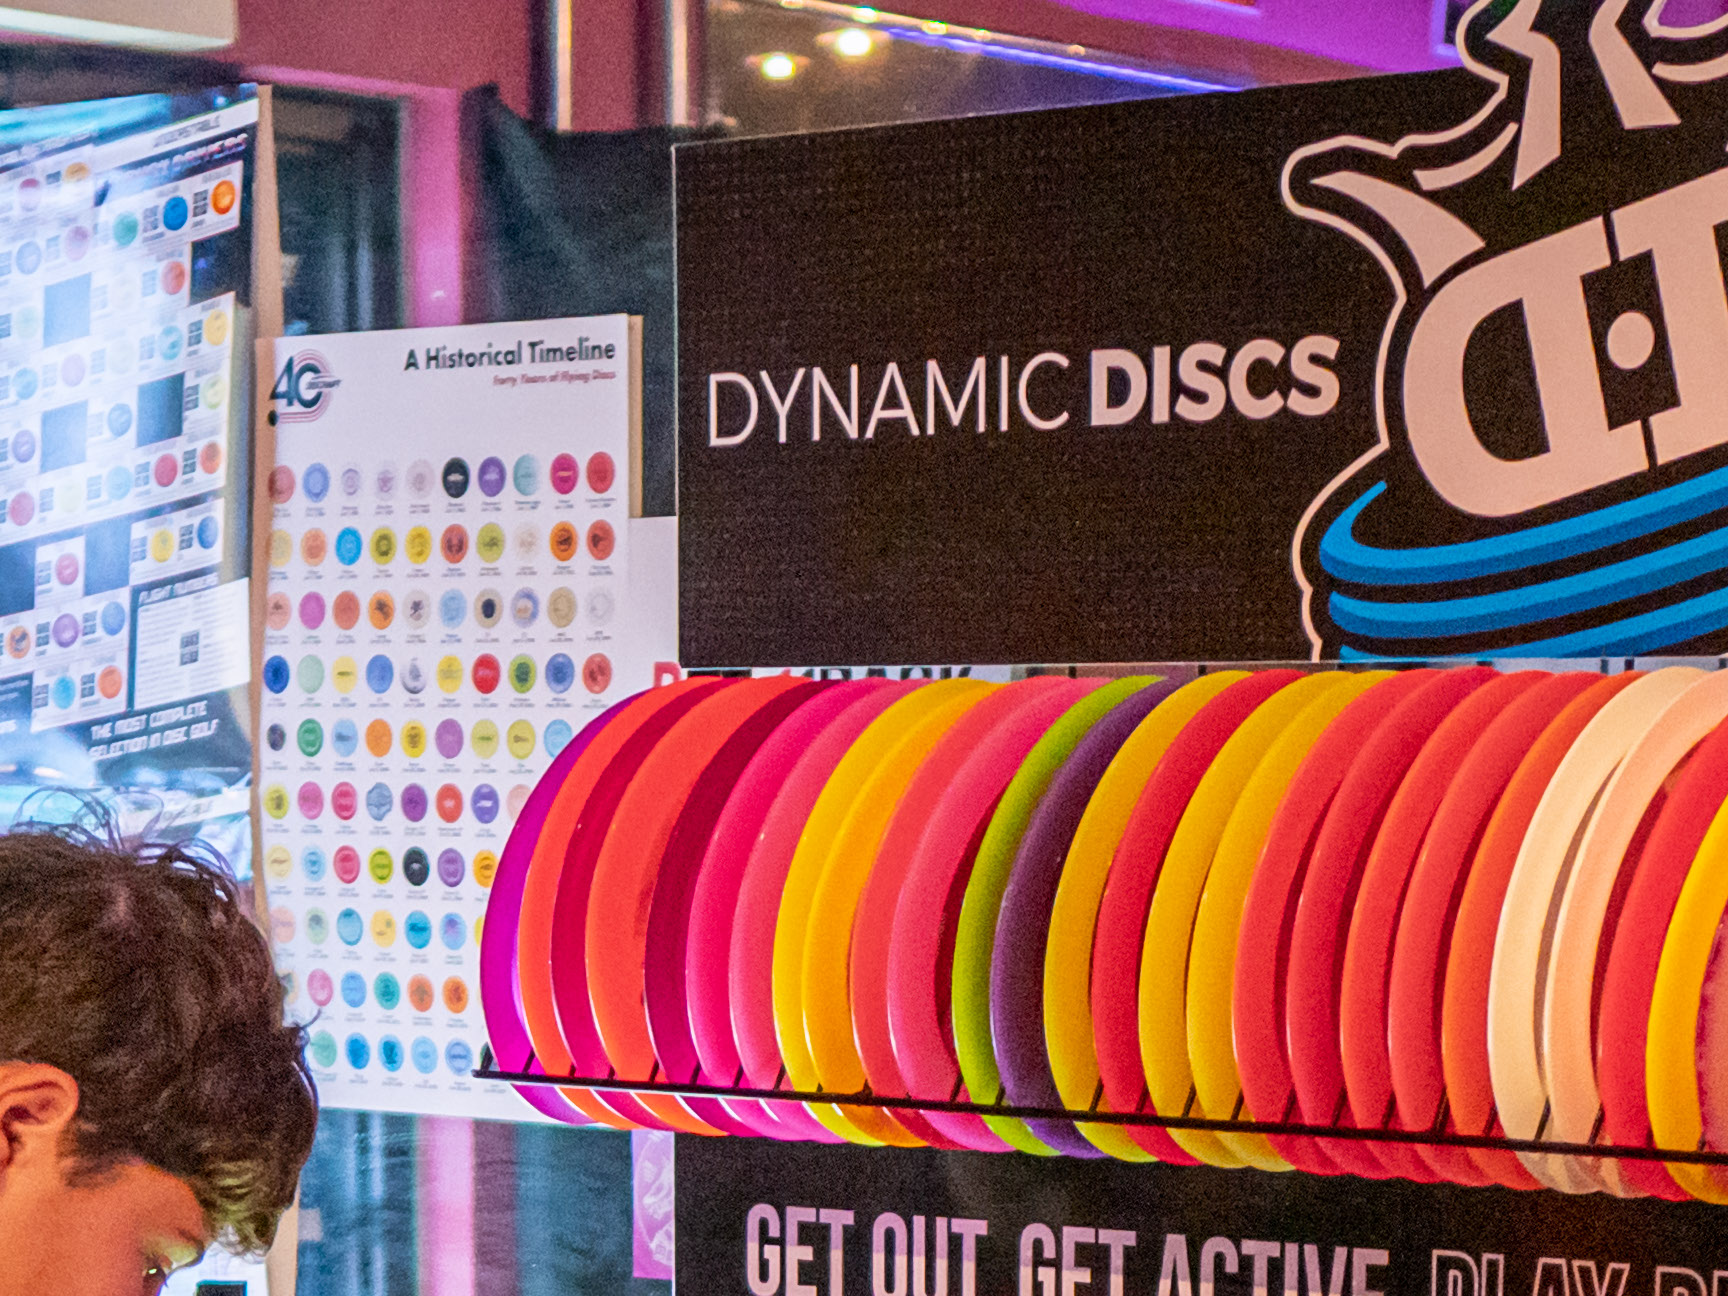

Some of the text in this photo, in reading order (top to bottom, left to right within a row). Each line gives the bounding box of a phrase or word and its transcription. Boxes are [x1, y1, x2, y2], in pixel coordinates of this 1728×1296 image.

[404, 336, 616, 371] A Historical Timeline
[708, 335, 1340, 447] DYNAMIC DISCS
